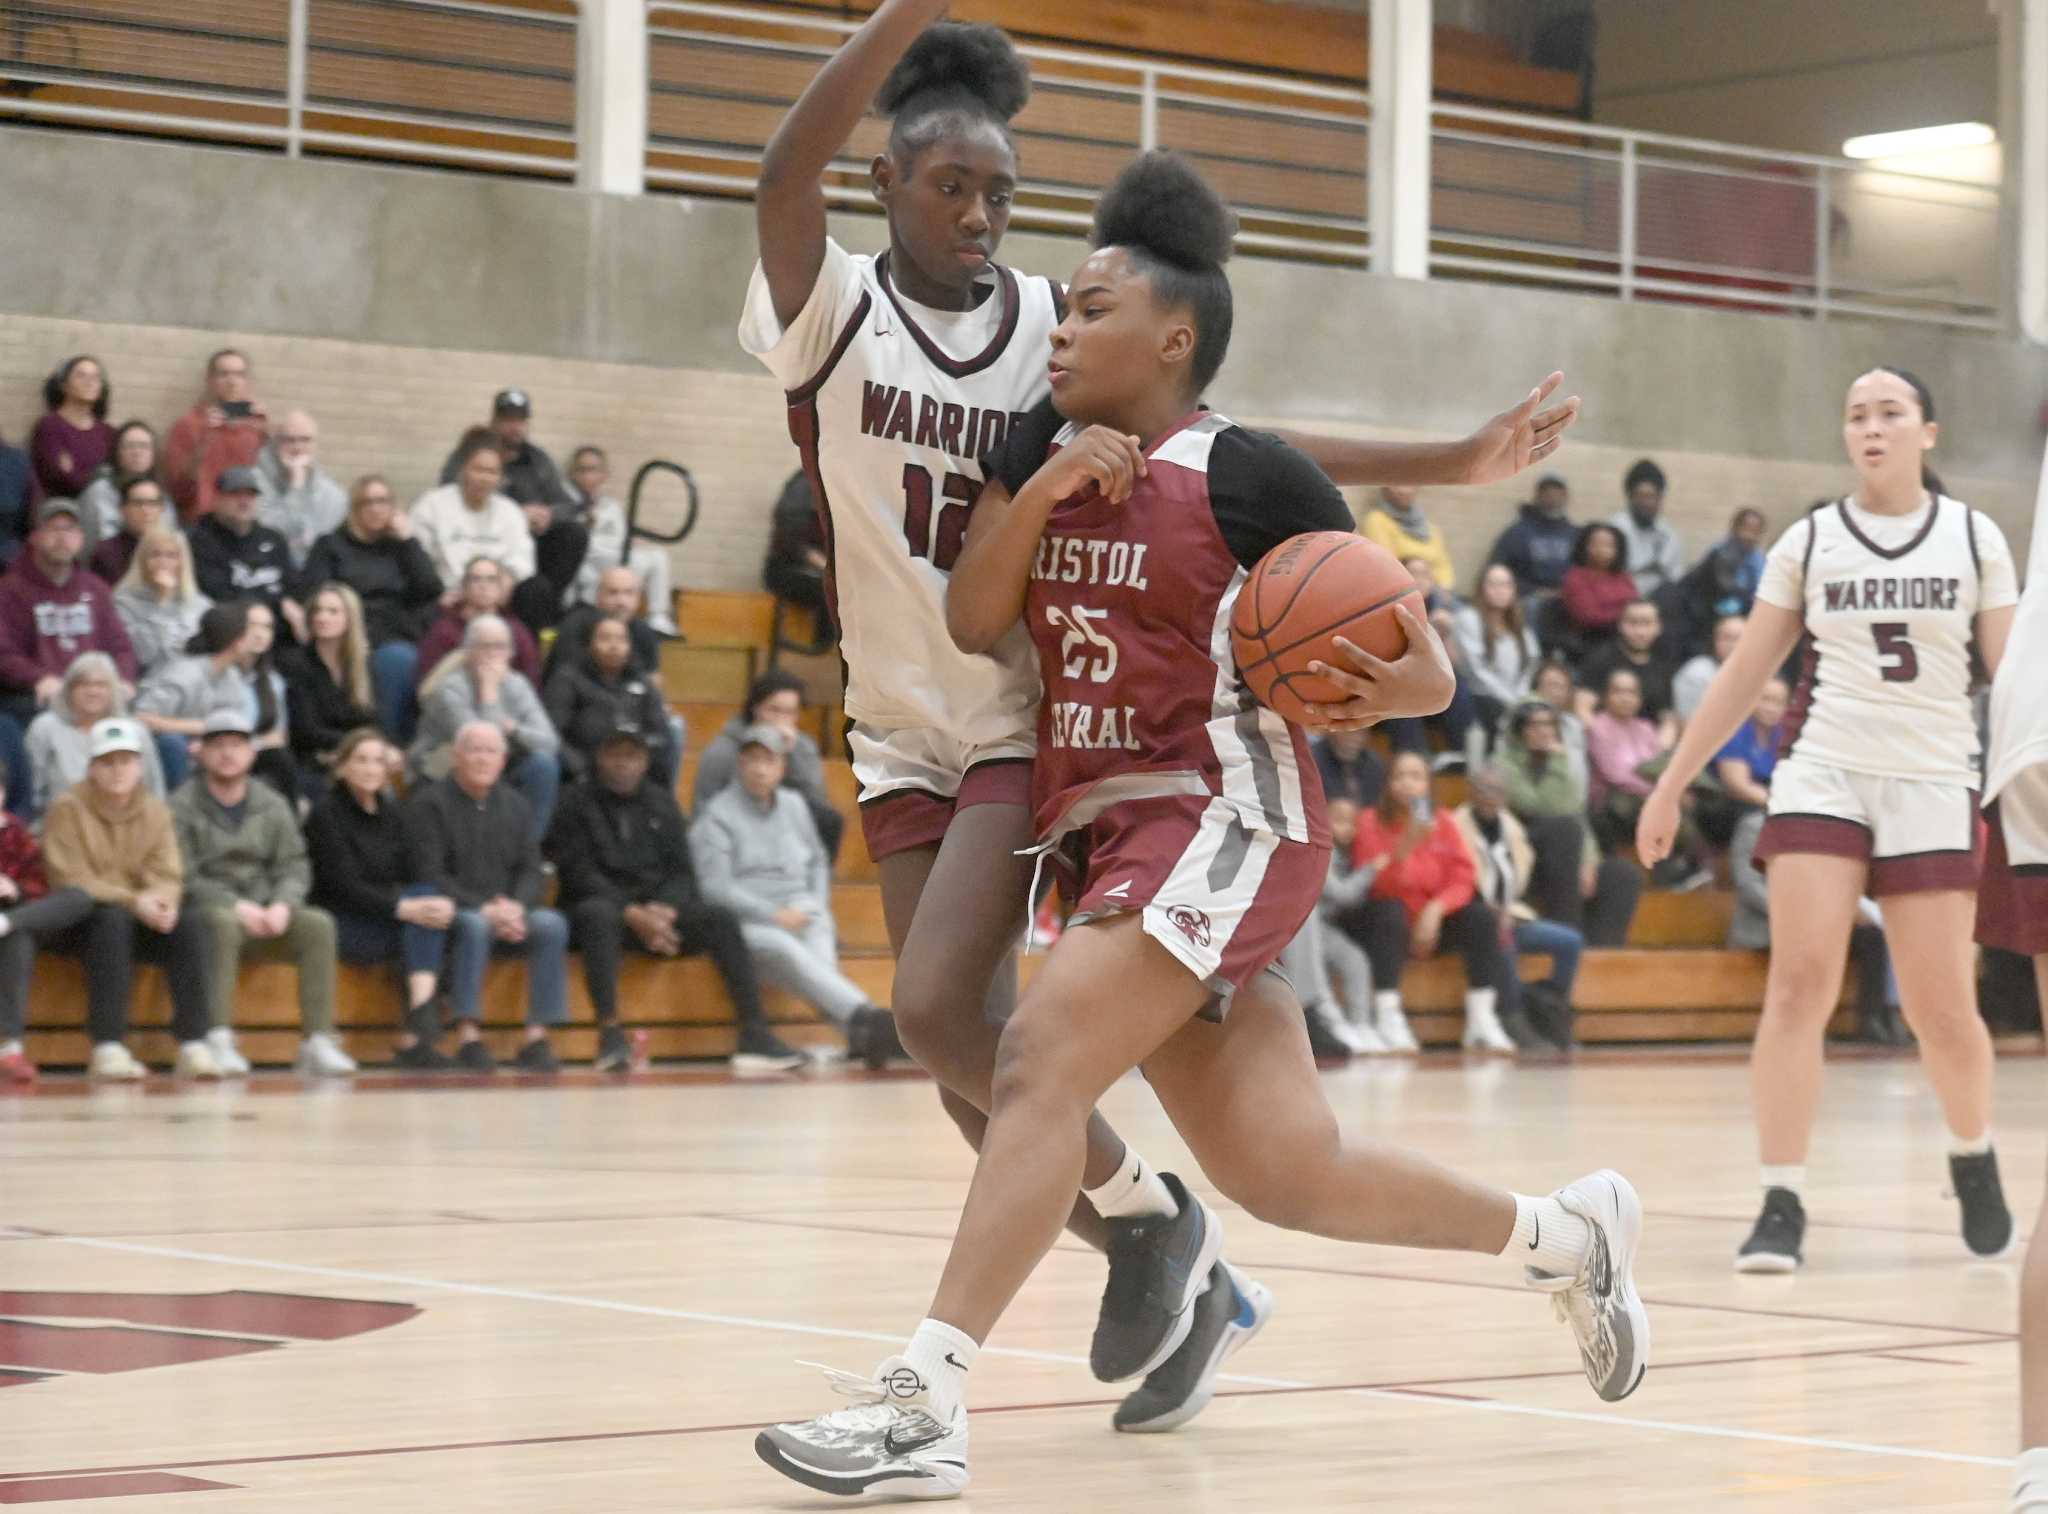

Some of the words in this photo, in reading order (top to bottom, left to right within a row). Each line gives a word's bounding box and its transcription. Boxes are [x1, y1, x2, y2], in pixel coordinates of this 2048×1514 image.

[902, 463, 985, 572] 12
[1031, 536, 1148, 592] RISTOL
[1824, 577, 1959, 612] WARRIORS
[1046, 605, 1118, 683] 25
[1870, 622, 1918, 682] 5
